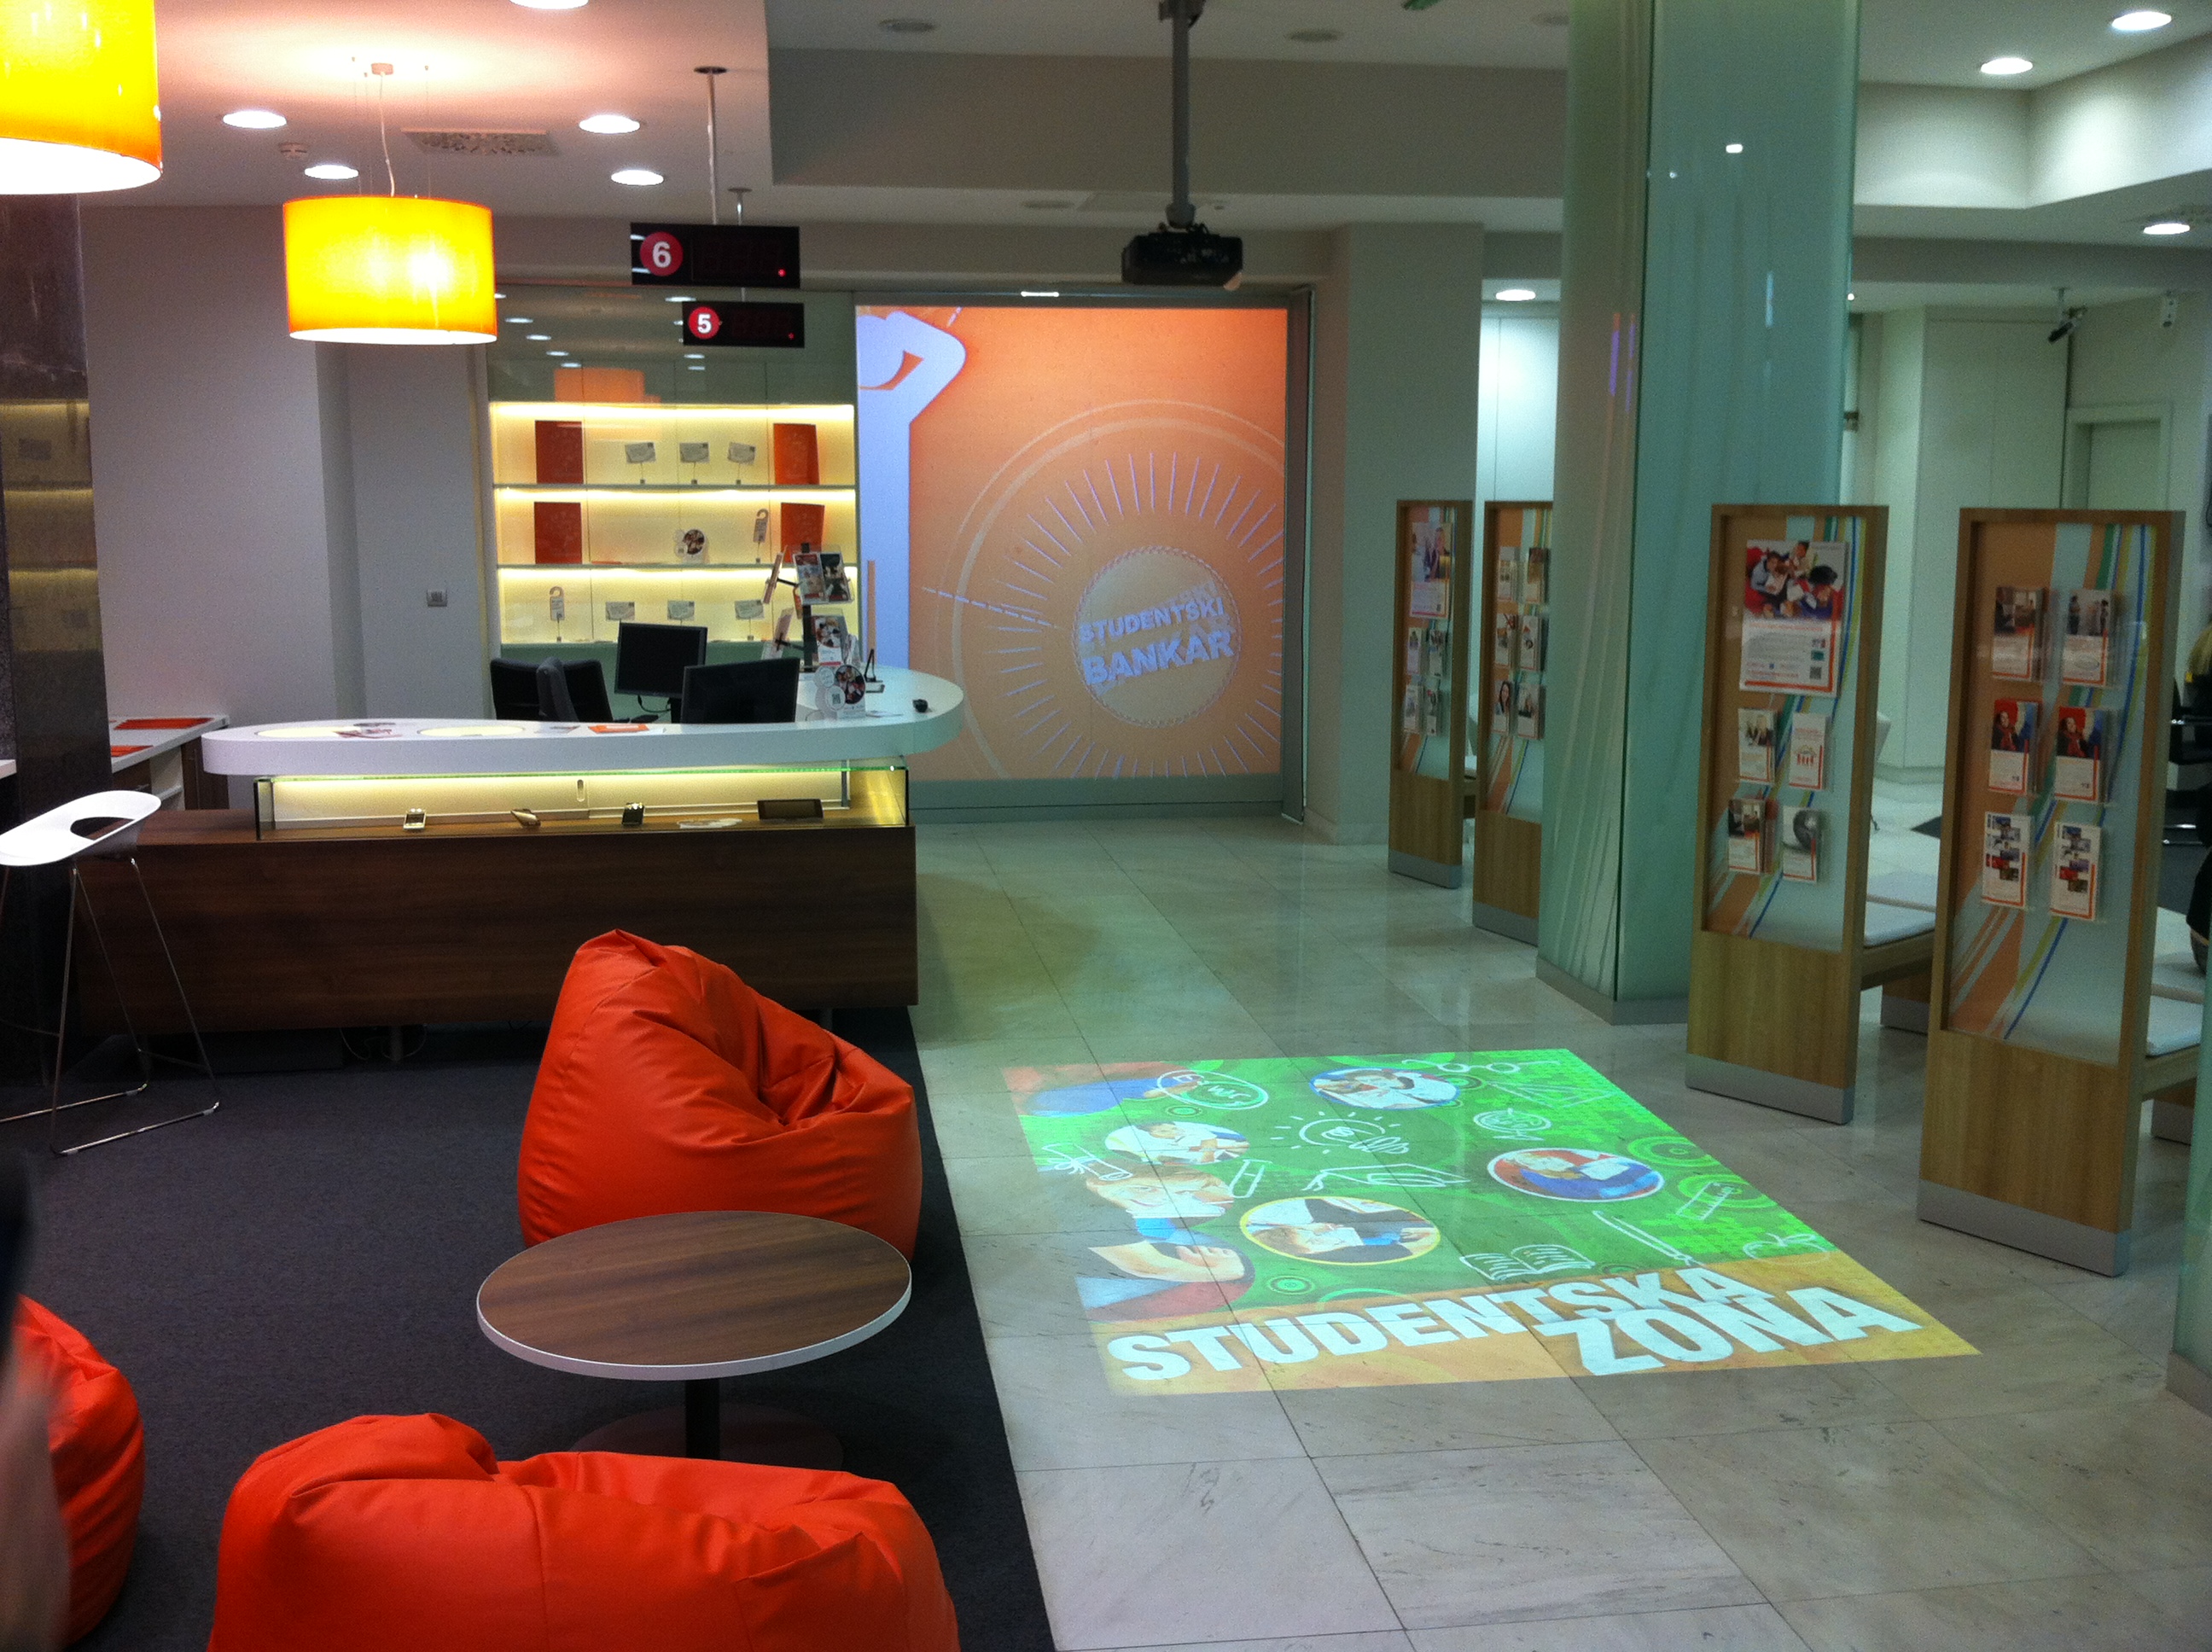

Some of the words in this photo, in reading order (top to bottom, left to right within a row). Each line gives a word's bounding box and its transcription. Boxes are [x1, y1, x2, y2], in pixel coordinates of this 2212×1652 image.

[652, 241, 672, 268] 6
[697, 312, 713, 334] 5
[1079, 596, 1225, 645] STUDENTSKI
[1082, 630, 1234, 685] BANKAR
[1108, 1267, 1775, 1380] STUDENTSKA
[1534, 1287, 1924, 1376] ZONA
